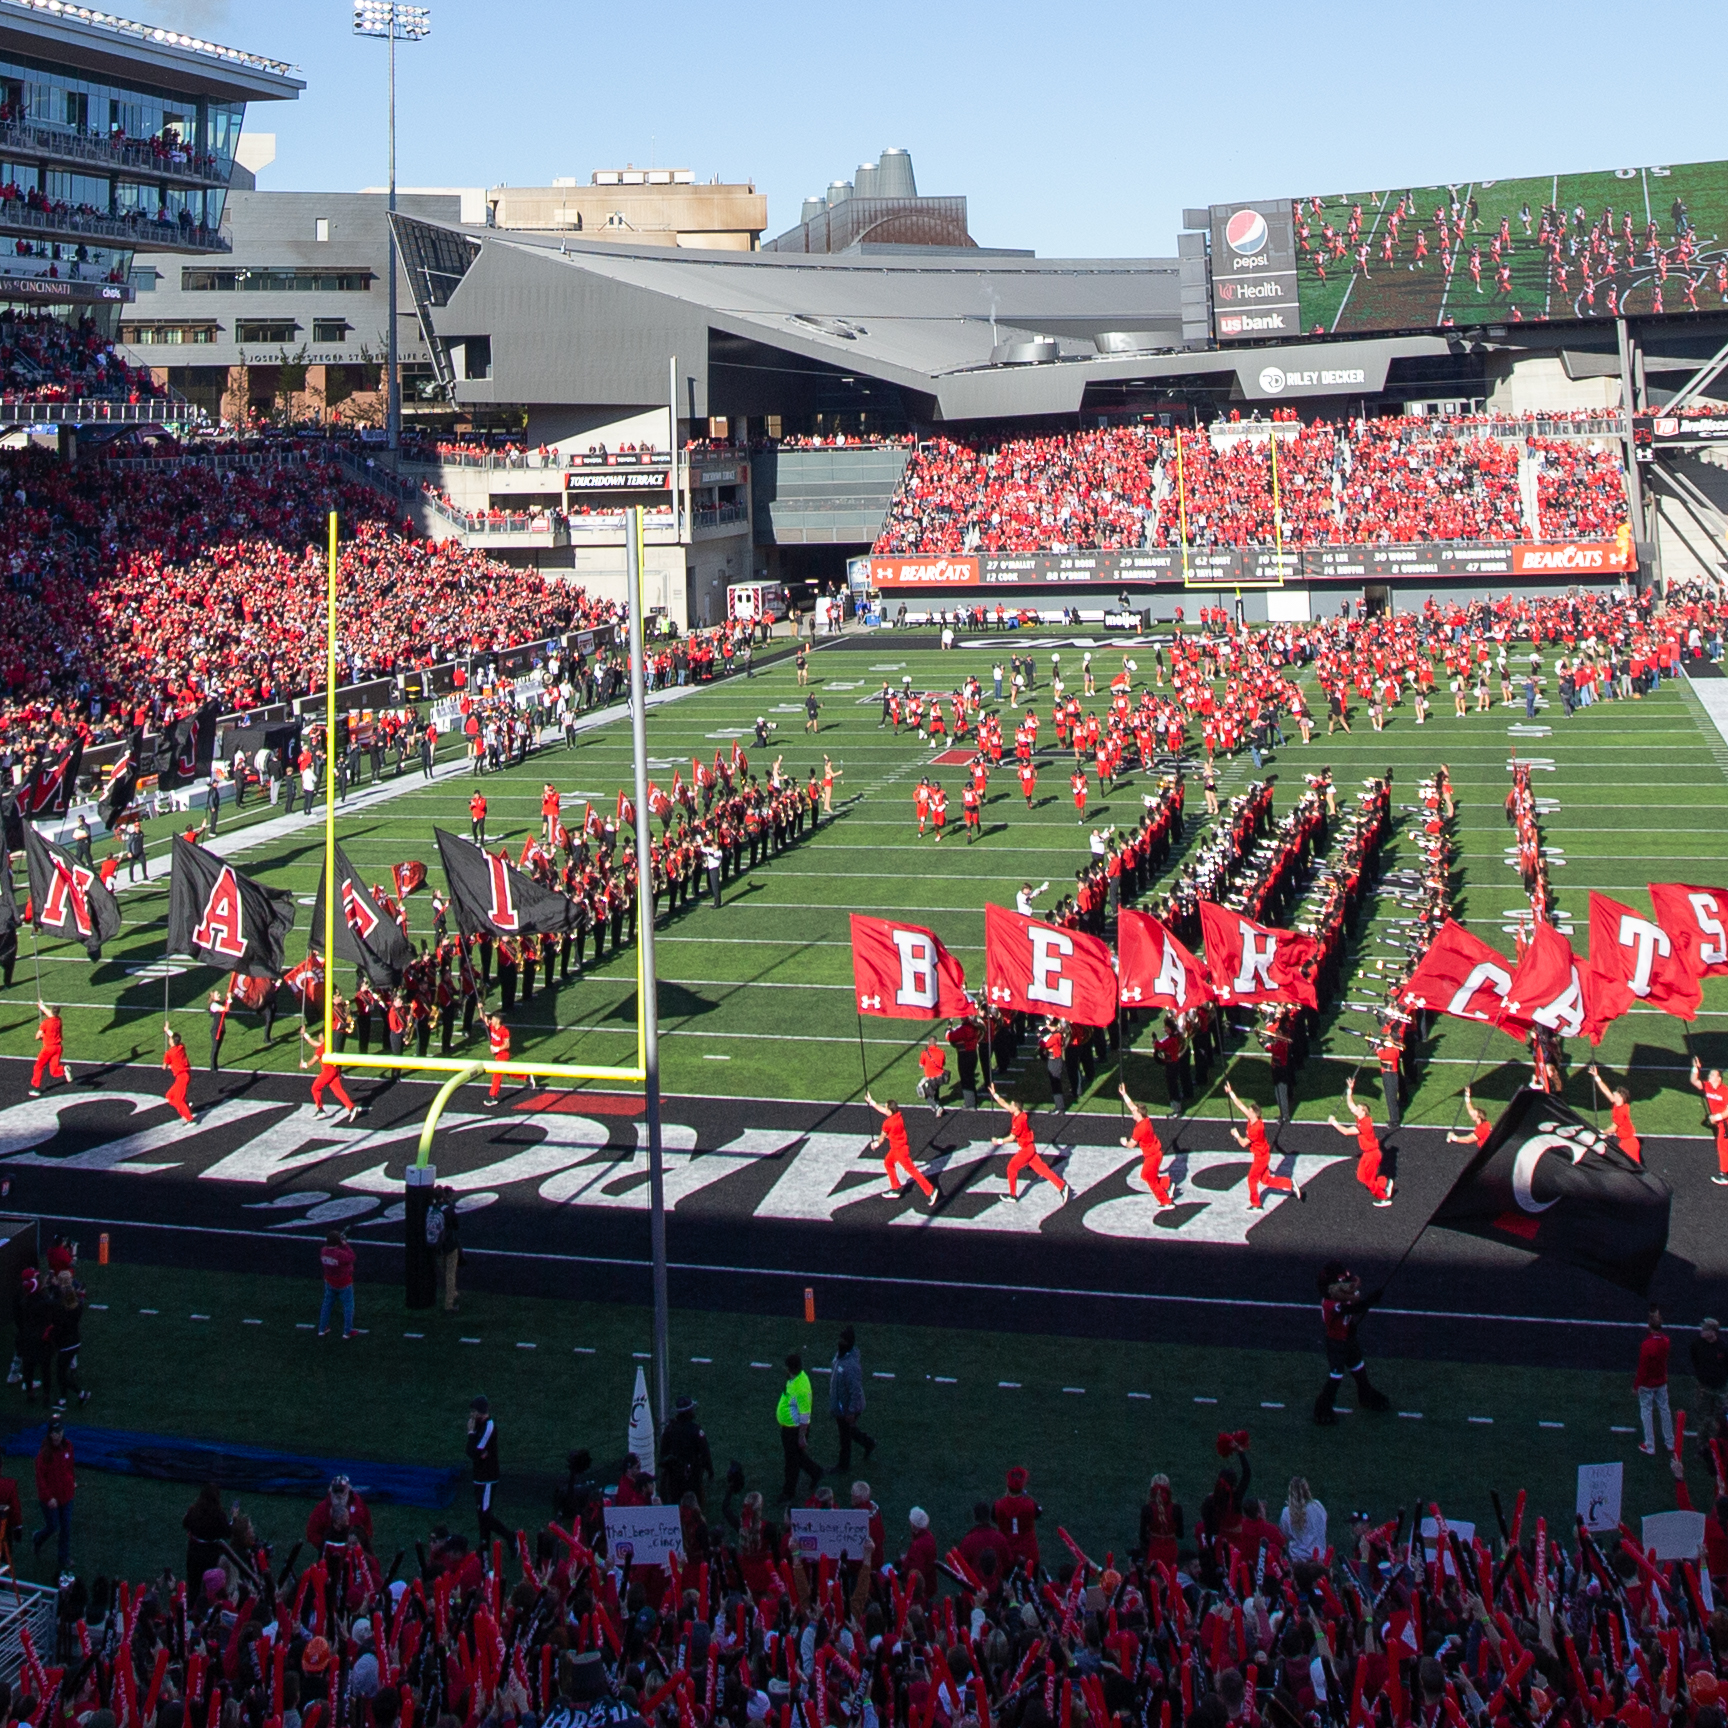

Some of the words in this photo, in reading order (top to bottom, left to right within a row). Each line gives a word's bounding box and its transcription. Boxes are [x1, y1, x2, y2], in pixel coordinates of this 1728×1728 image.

[1233, 254, 1269, 271] pepsi
[20, 281, 72, 295] CINCINNATI
[398, 353, 418, 361] LIFE
[1286, 371, 1319, 386] RILEY
[1321, 369, 1365, 384] DECKER
[569, 475, 626, 487] TOUCHDOWN
[627, 474, 664, 486] TERRACE
[1522, 547, 1603, 569] BEARCATS
[899, 560, 971, 582] BEARCATS
[1105, 610, 1142, 629] meijer
[192, 864, 249, 958] A
[1688, 892, 1727, 965] S
[1026, 926, 1074, 1008] E
[1618, 914, 1672, 998] T
[892, 928, 940, 1010] B
[1153, 930, 1188, 1008] A
